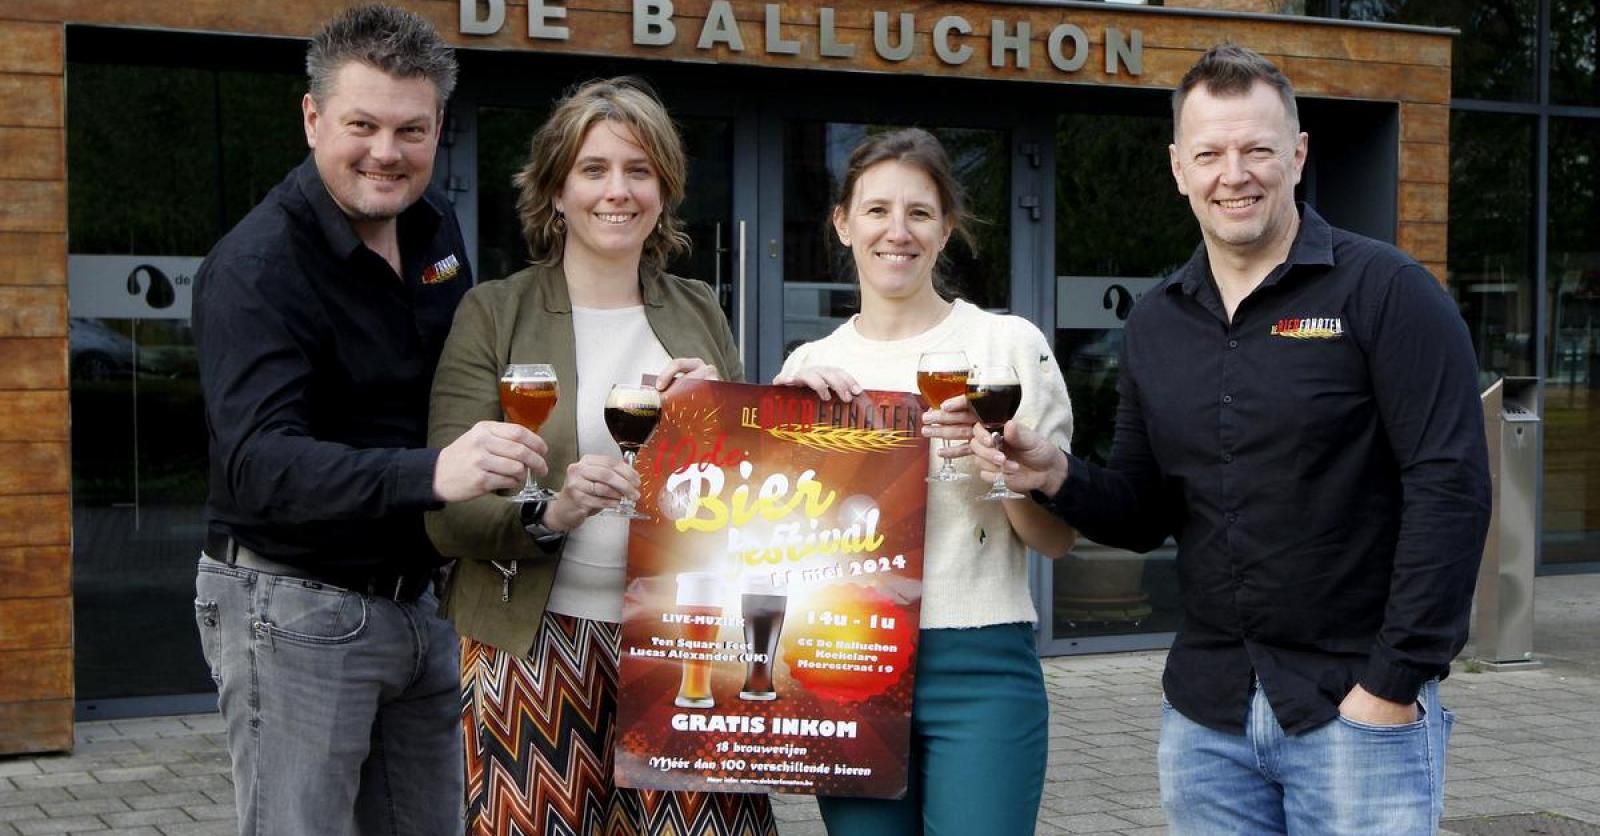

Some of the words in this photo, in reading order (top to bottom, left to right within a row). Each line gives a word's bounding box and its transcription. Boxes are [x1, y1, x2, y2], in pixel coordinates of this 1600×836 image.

[460, 0, 569, 40] DE
[632, 0, 1144, 76] BALLUCHON
[741, 407, 760, 428] DE
[666, 460, 836, 533] Bier
[849, 554, 907, 577] 2024
[807, 610, 848, 627] 14u
[869, 614, 897, 630] 1u
[651, 637, 675, 647] Ten
[676, 639, 722, 651] Square
[835, 640, 898, 653] Balluchon
[630, 647, 667, 658] Lucas
[668, 650, 737, 662] Alexander
[738, 653, 770, 665] (UK)
[671, 714, 766, 733] GRATIS
[771, 718, 858, 738] INKOM
[715, 742, 730, 753] 18
[732, 742, 808, 757] brouwerijen
[693, 759, 717, 770] dan
[720, 760, 746, 772] 100
[750, 761, 832, 775] verschillende
[834, 764, 872, 777] bieren
